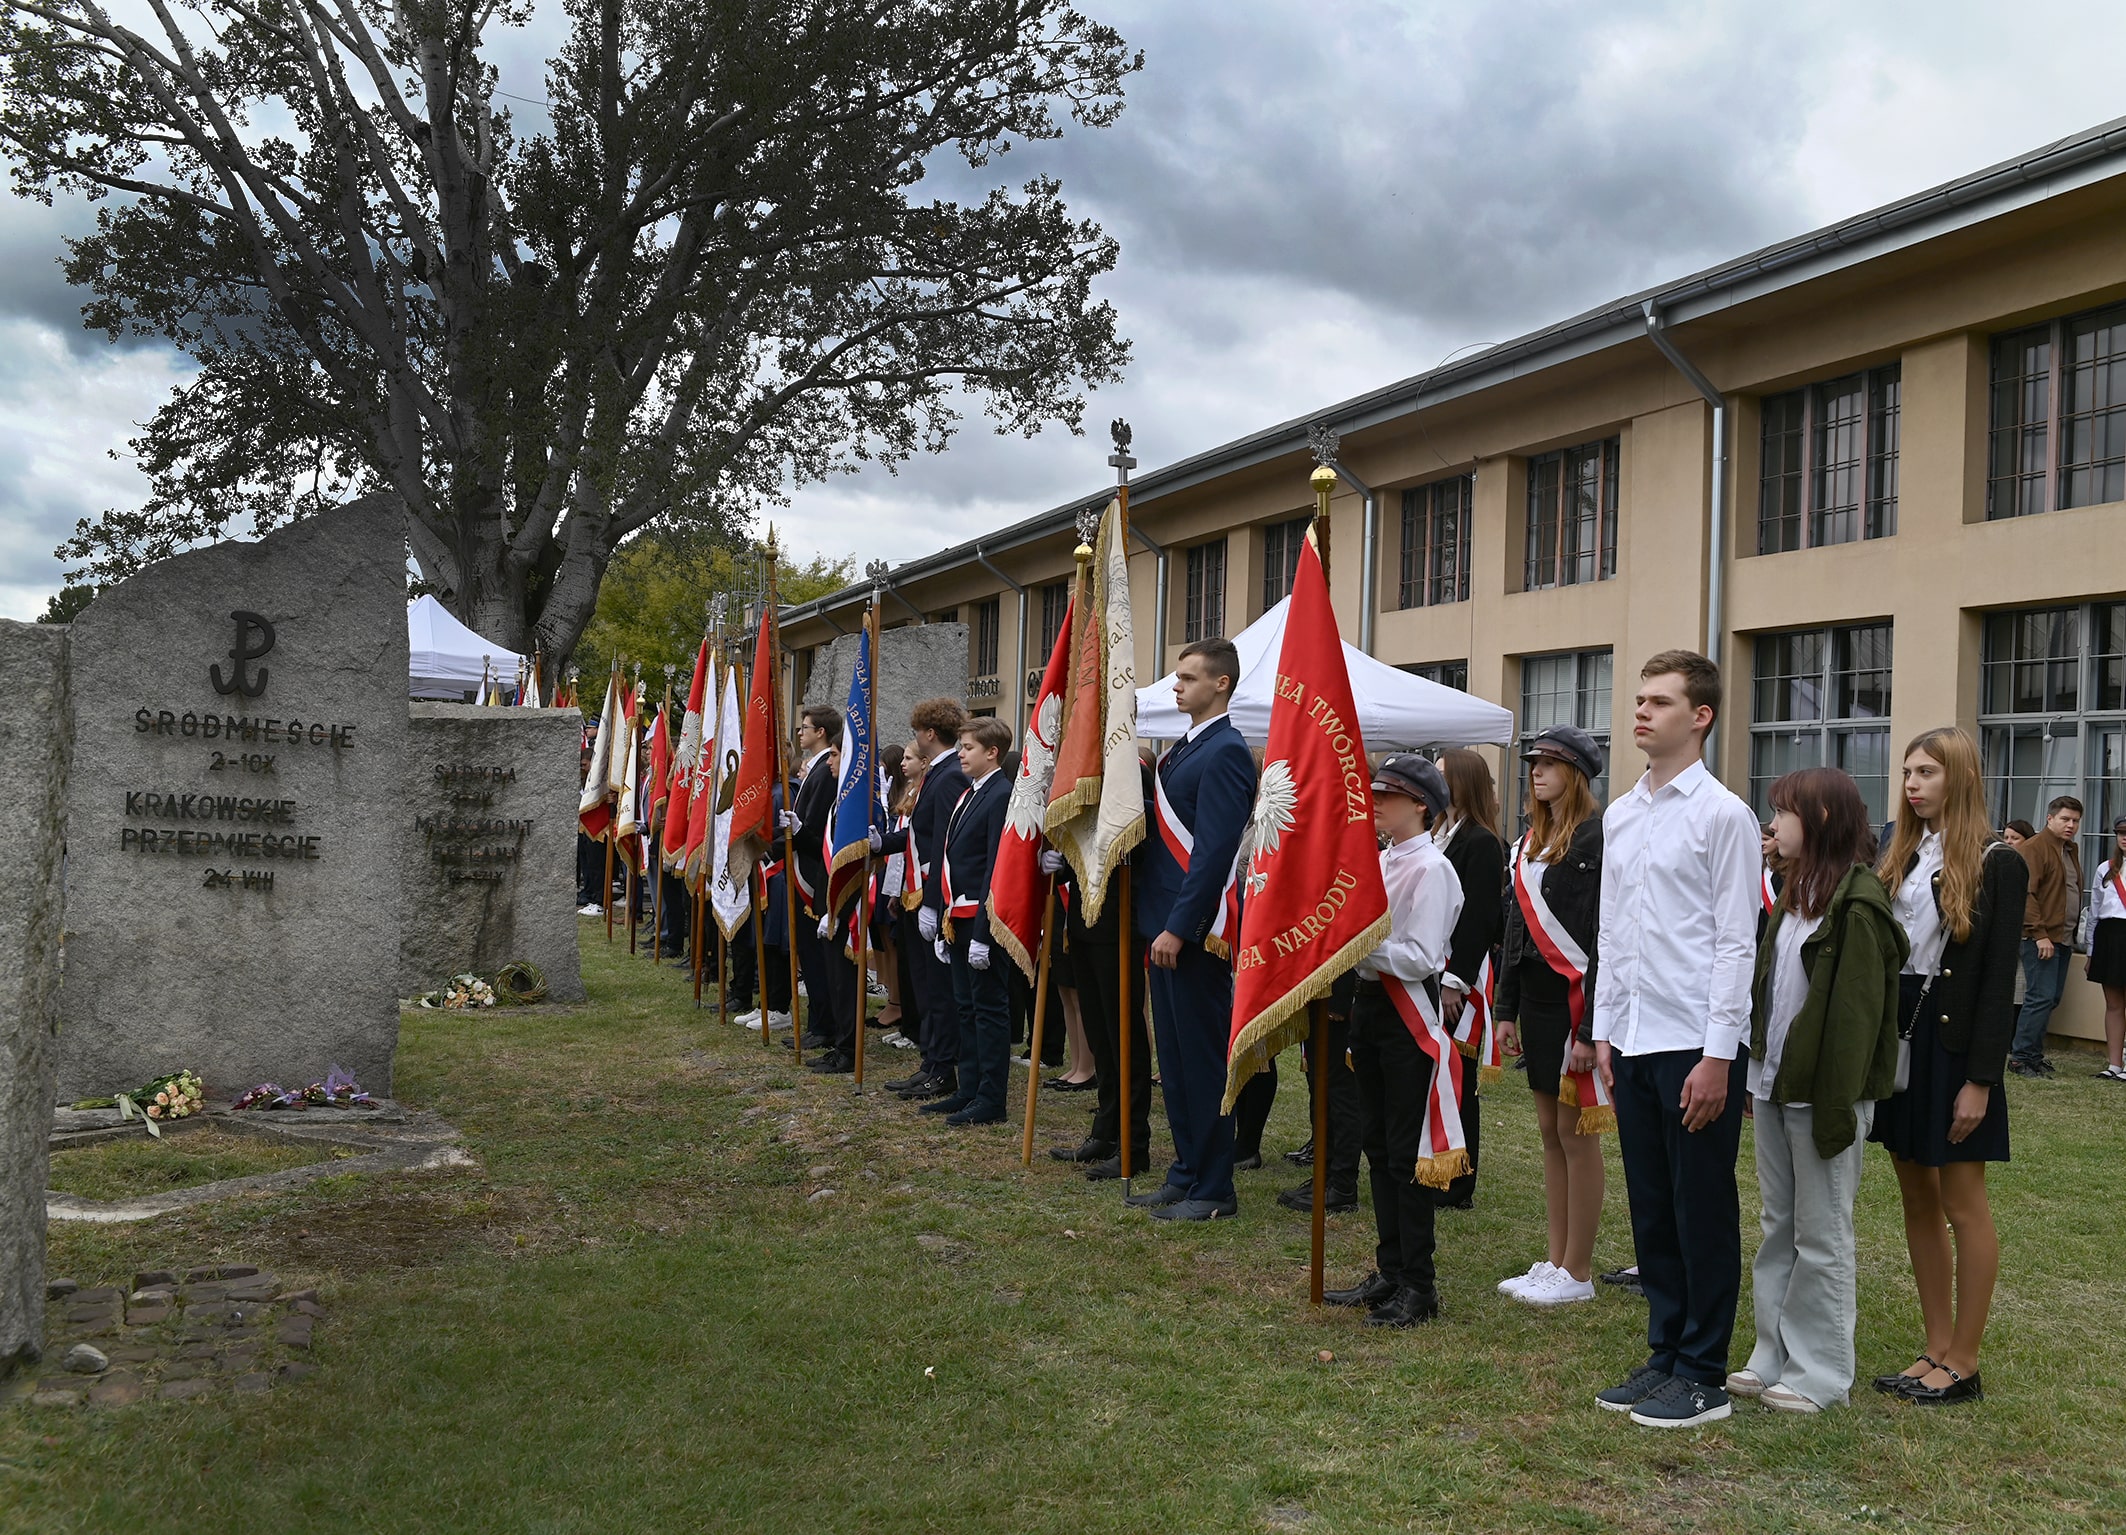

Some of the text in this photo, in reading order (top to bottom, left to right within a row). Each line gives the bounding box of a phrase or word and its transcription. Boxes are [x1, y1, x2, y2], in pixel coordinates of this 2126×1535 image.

[840, 703, 869, 801] Jana Paderew
[1274, 674, 1368, 824] IŁA TWÓRCZA
[121, 828, 321, 860] PRZEDMIEŚCIE
[125, 791, 296, 824] KRAKOWSKIE
[1237, 869, 1357, 974] GA NARODU
